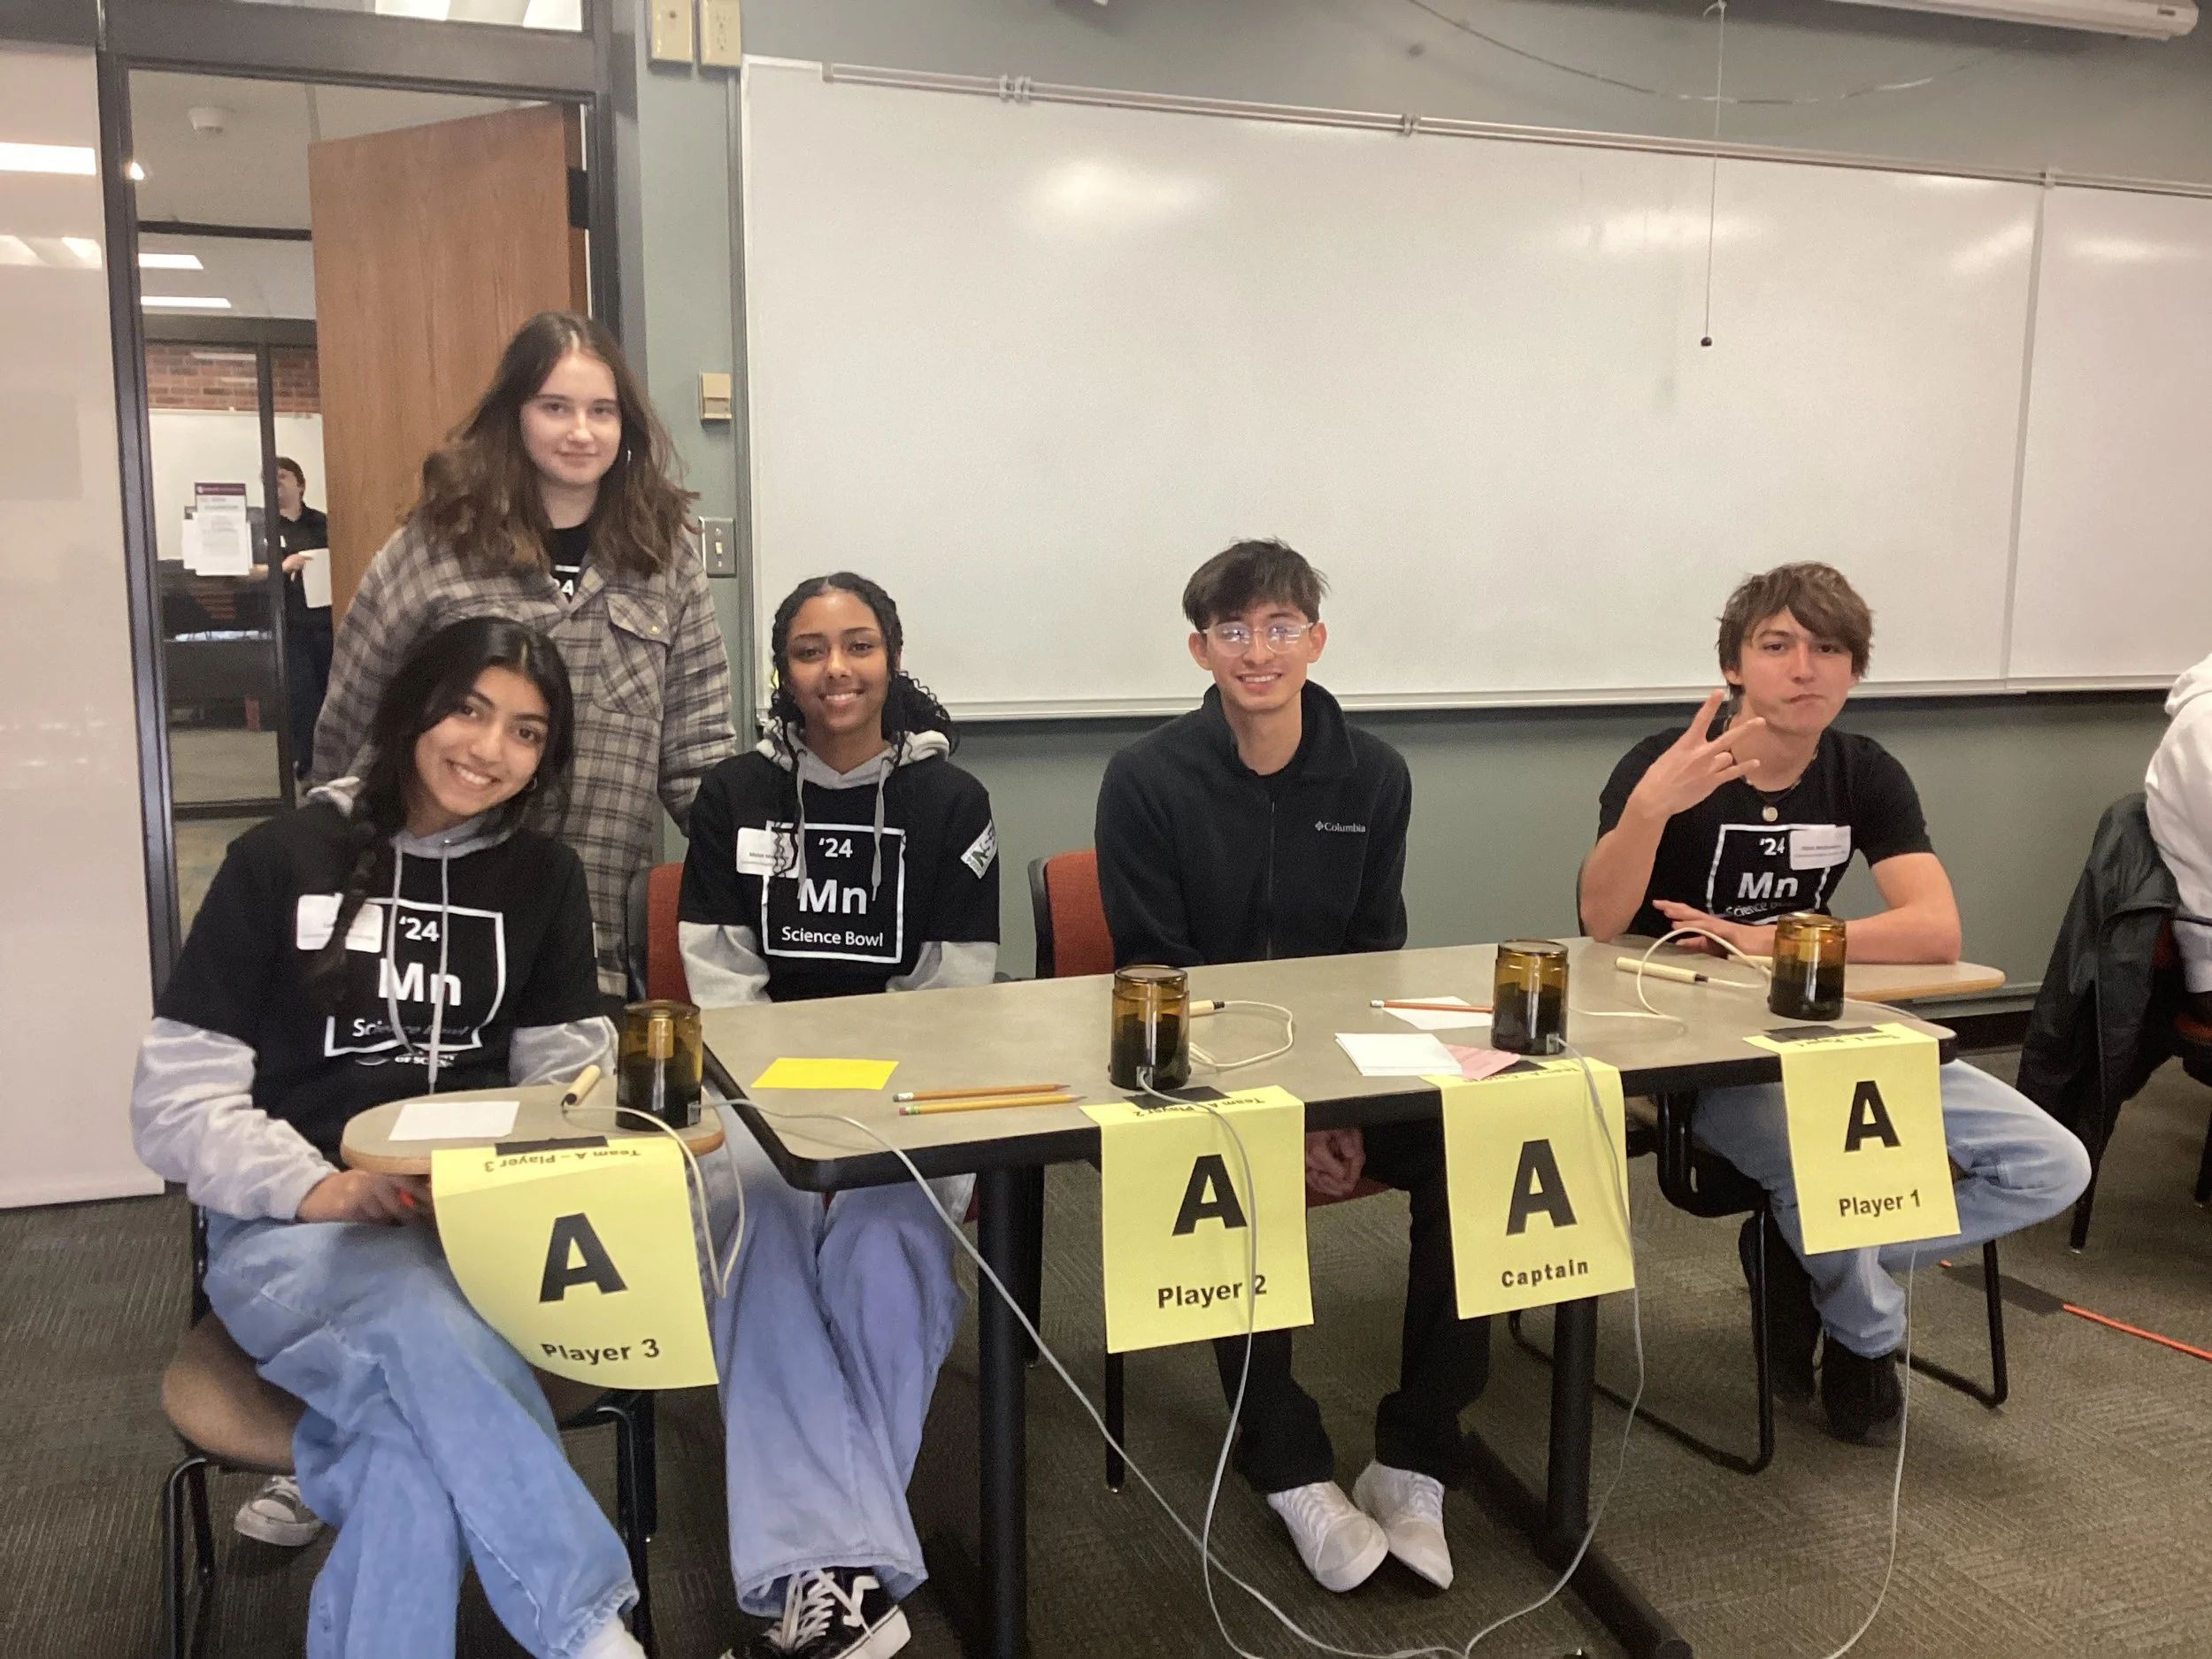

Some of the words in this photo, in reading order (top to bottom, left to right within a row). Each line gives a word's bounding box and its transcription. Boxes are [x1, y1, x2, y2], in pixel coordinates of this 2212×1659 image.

[1325, 822, 1366, 833] Columbia
[799, 878, 867, 915] Mn
[1737, 872, 1799, 899] Mn
[781, 926, 841, 946] Science
[845, 931, 883, 948] Bowl
[379, 957, 461, 1006] Mn
[1844, 1080, 1901, 1153] A
[484, 1161, 495, 1172] 3
[500, 1155, 556, 1168] Player
[1171, 1154, 1248, 1237] A
[1506, 1139, 1578, 1236] A
[1839, 1194, 1903, 1217] Player
[1910, 1189, 1921, 1208] 1
[539, 1212, 628, 1303] A
[1502, 1259, 1589, 1287] Captain
[1157, 1281, 1242, 1309] Player
[1253, 1274, 1267, 1294] 2
[541, 1342, 631, 1365] Player
[641, 1339, 660, 1358] 3
